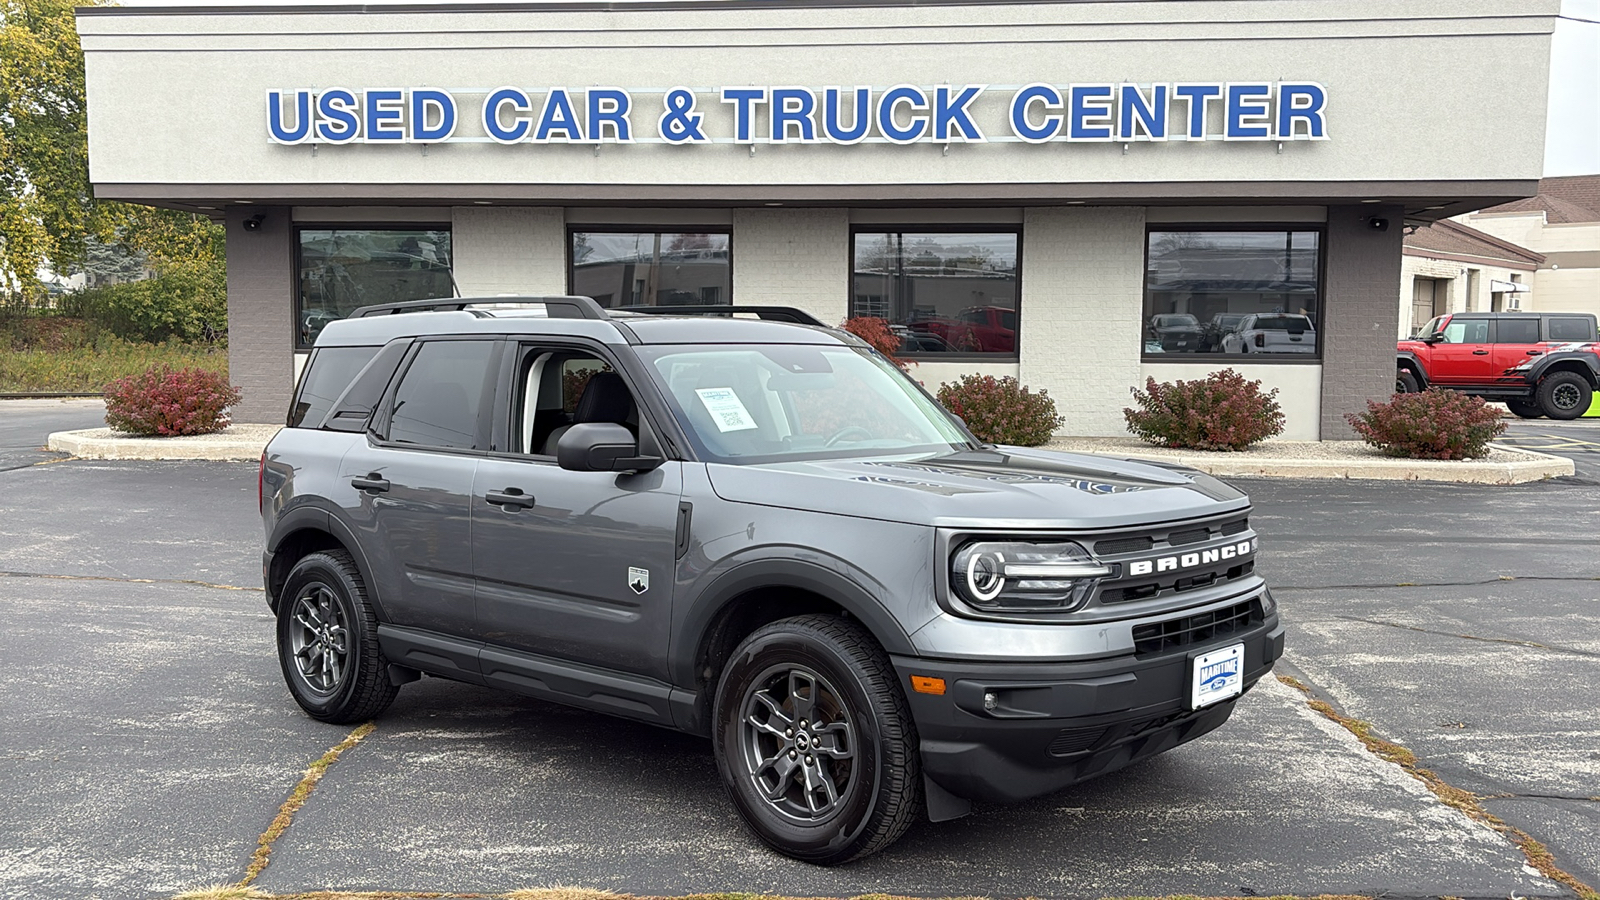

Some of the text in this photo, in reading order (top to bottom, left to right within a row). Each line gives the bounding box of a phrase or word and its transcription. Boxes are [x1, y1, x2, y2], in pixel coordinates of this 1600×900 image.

[266, 81, 1331, 145] USED CAR & TRUCK CENTER
[1129, 541, 1250, 576] BRONCO
[1201, 659, 1237, 684] MARITIME
